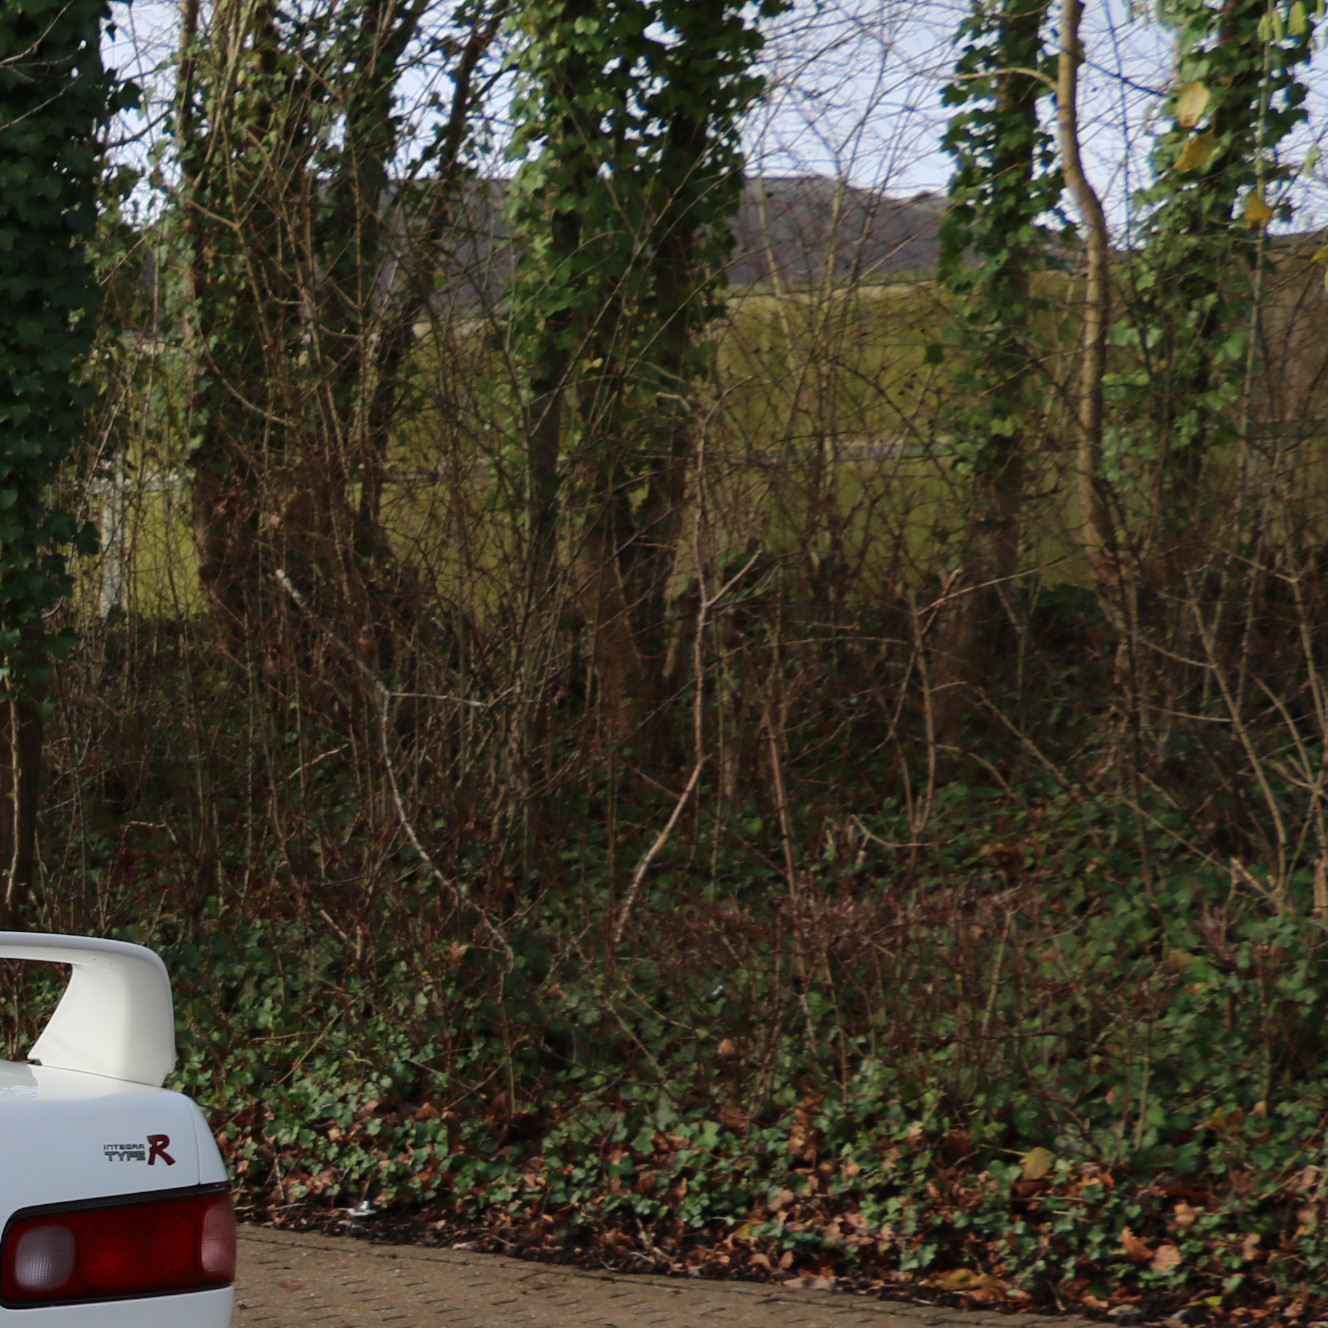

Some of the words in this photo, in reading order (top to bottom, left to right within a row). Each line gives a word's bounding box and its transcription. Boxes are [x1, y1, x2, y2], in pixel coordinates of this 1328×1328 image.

[103, 1143, 145, 1151] INTEGRA
[104, 1150, 147, 1162] TYPE
[146, 1133, 176, 1166] R
